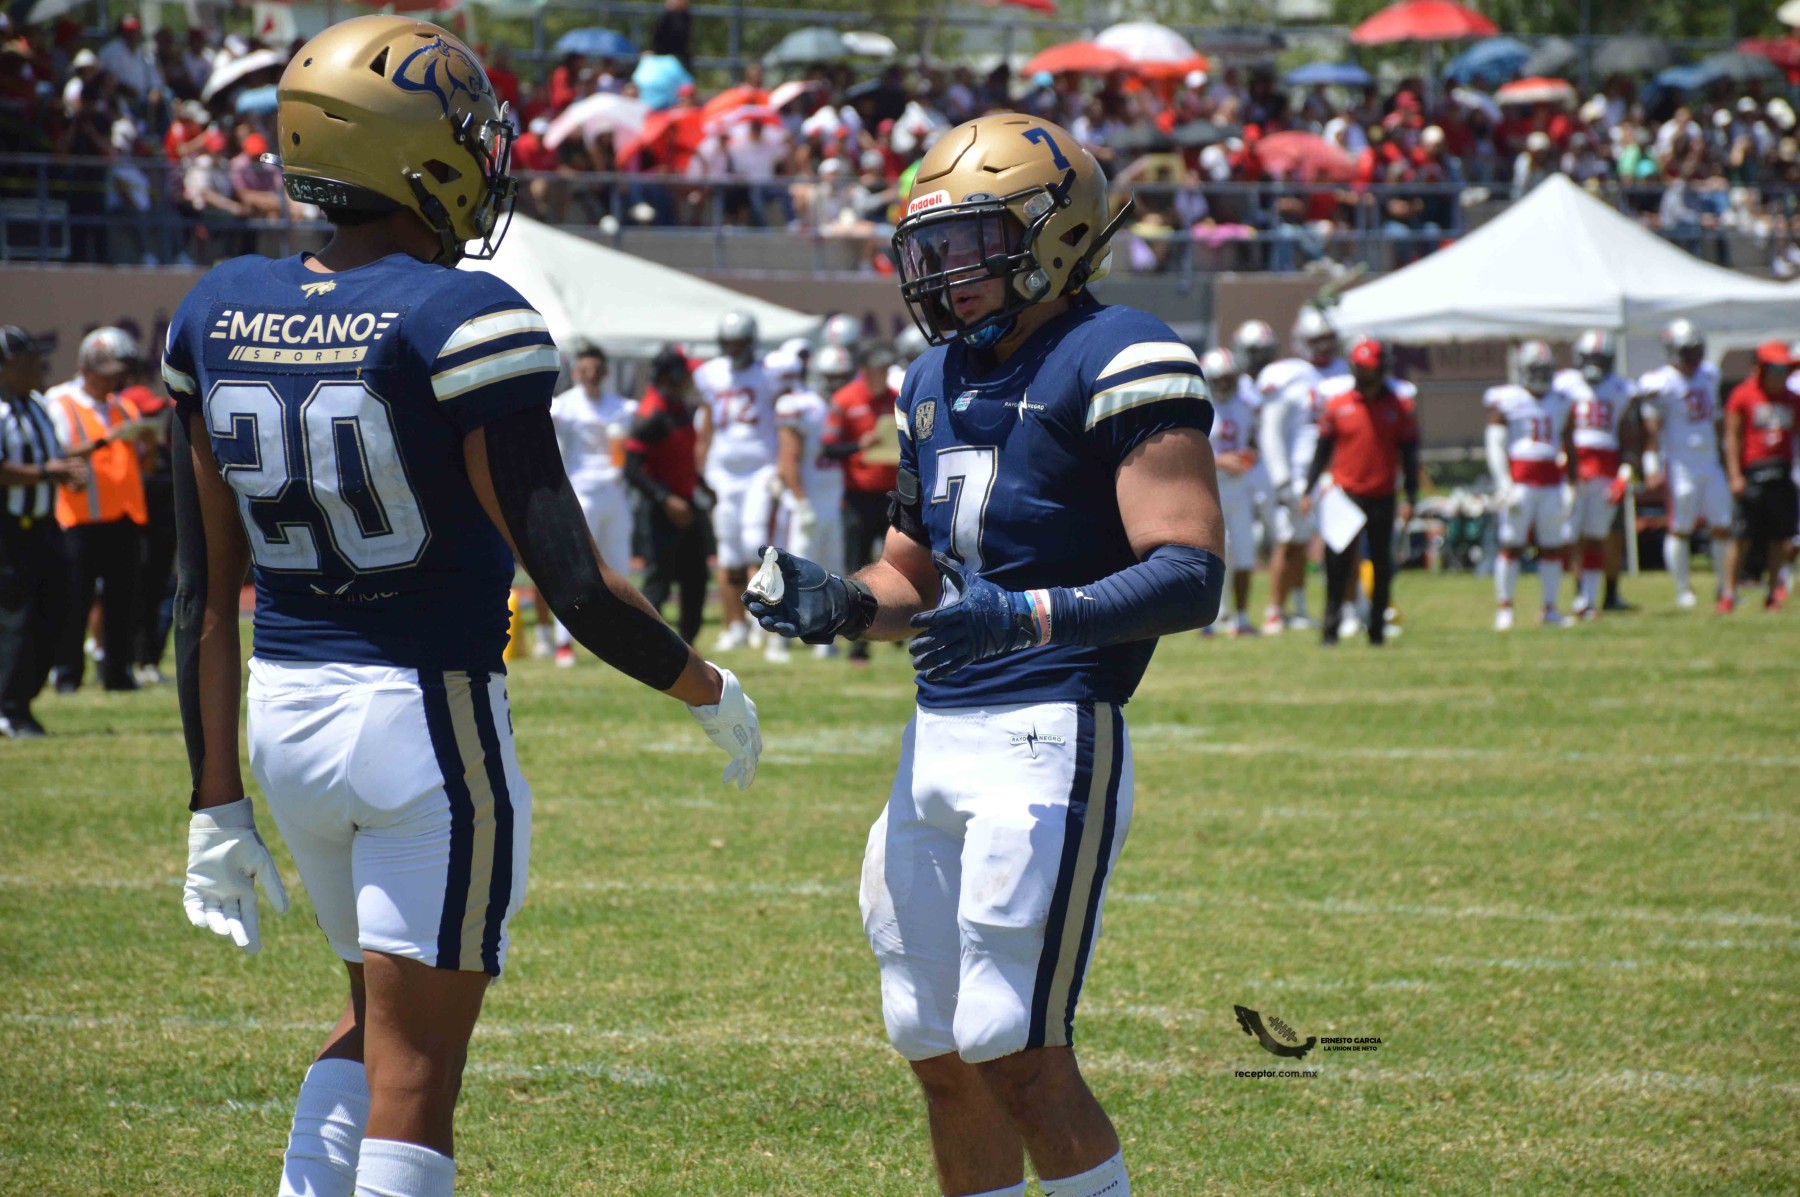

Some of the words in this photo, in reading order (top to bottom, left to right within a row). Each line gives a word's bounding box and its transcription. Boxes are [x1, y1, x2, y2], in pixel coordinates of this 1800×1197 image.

[1021, 126, 1071, 171] 7
[910, 194, 943, 213] Riddell
[229, 311, 376, 344] MECANO
[253, 349, 359, 362] SPORTS
[207, 380, 432, 574] 20
[931, 445, 998, 605] 7
